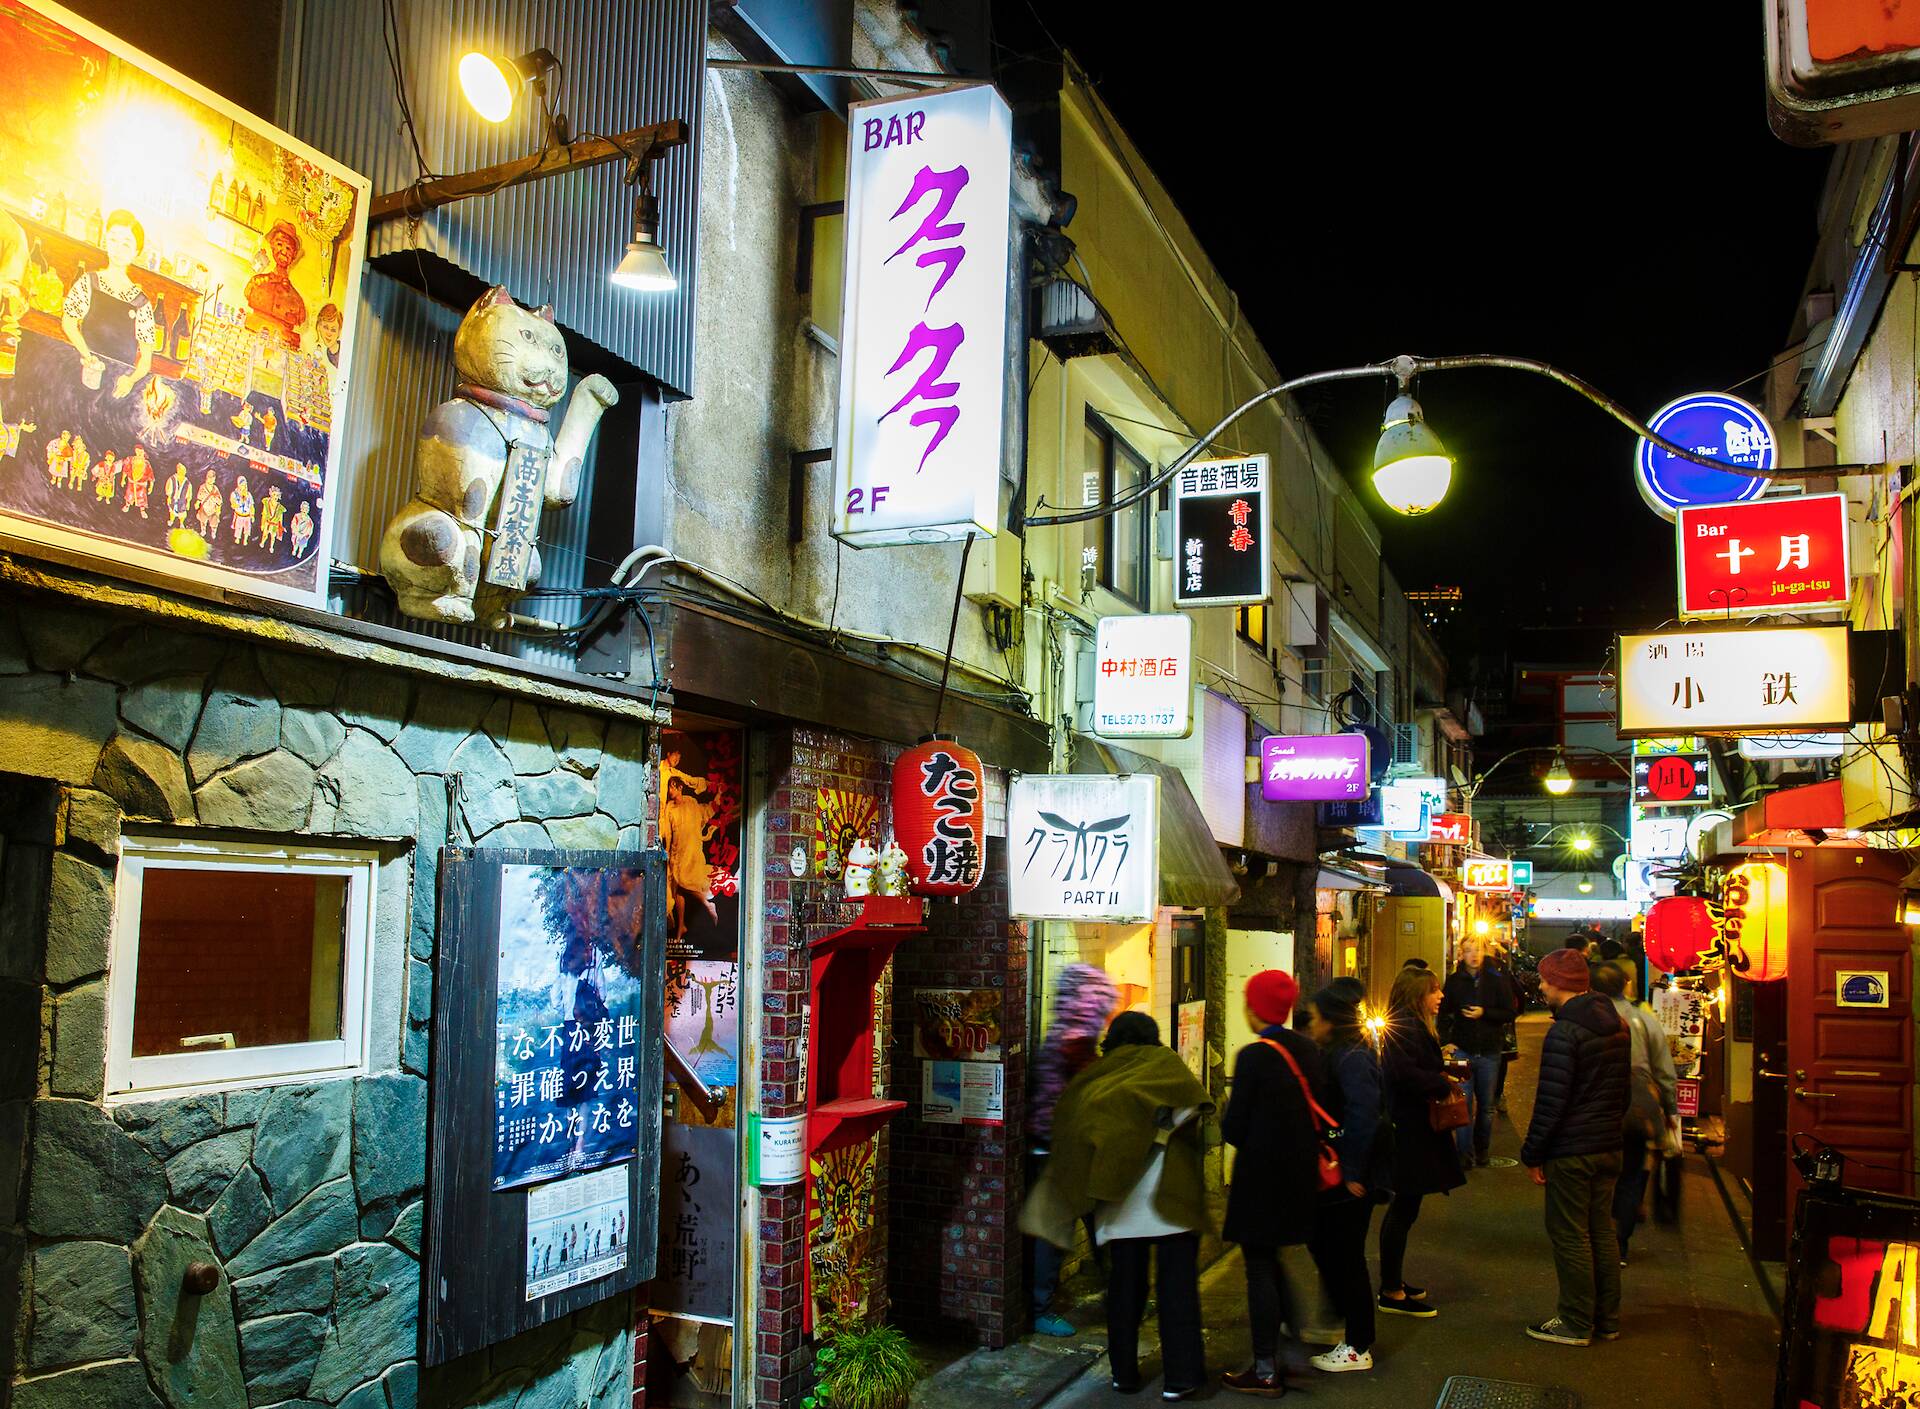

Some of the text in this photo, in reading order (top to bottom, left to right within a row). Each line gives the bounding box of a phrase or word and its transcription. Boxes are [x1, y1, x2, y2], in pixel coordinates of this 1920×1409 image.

[863, 110, 926, 152] BAR
[1181, 462, 1259, 494] 音盤酒場
[493, 449, 541, 580] 商売繁盛
[847, 486, 890, 514] 2F
[1227, 498, 1255, 552] 青春
[1696, 523, 1728, 537] Bar
[1184, 538, 1203, 591] 新宿店
[1715, 533, 1811, 574] 十月
[1770, 579, 1831, 597] ju-ga-tsu
[1101, 657, 1178, 678] 中村酒店
[1672, 672, 1798, 709] 小鉄
[1346, 783, 1360, 792] 2F
[920, 752, 979, 887] たこ焼
[1063, 891, 1105, 905] PART
[509, 1027, 536, 1108] な罪
[539, 1022, 565, 1145] 不確か
[566, 1022, 590, 1139] かった
[592, 1017, 615, 1133] 変えな
[617, 1015, 638, 1128] 世界を
